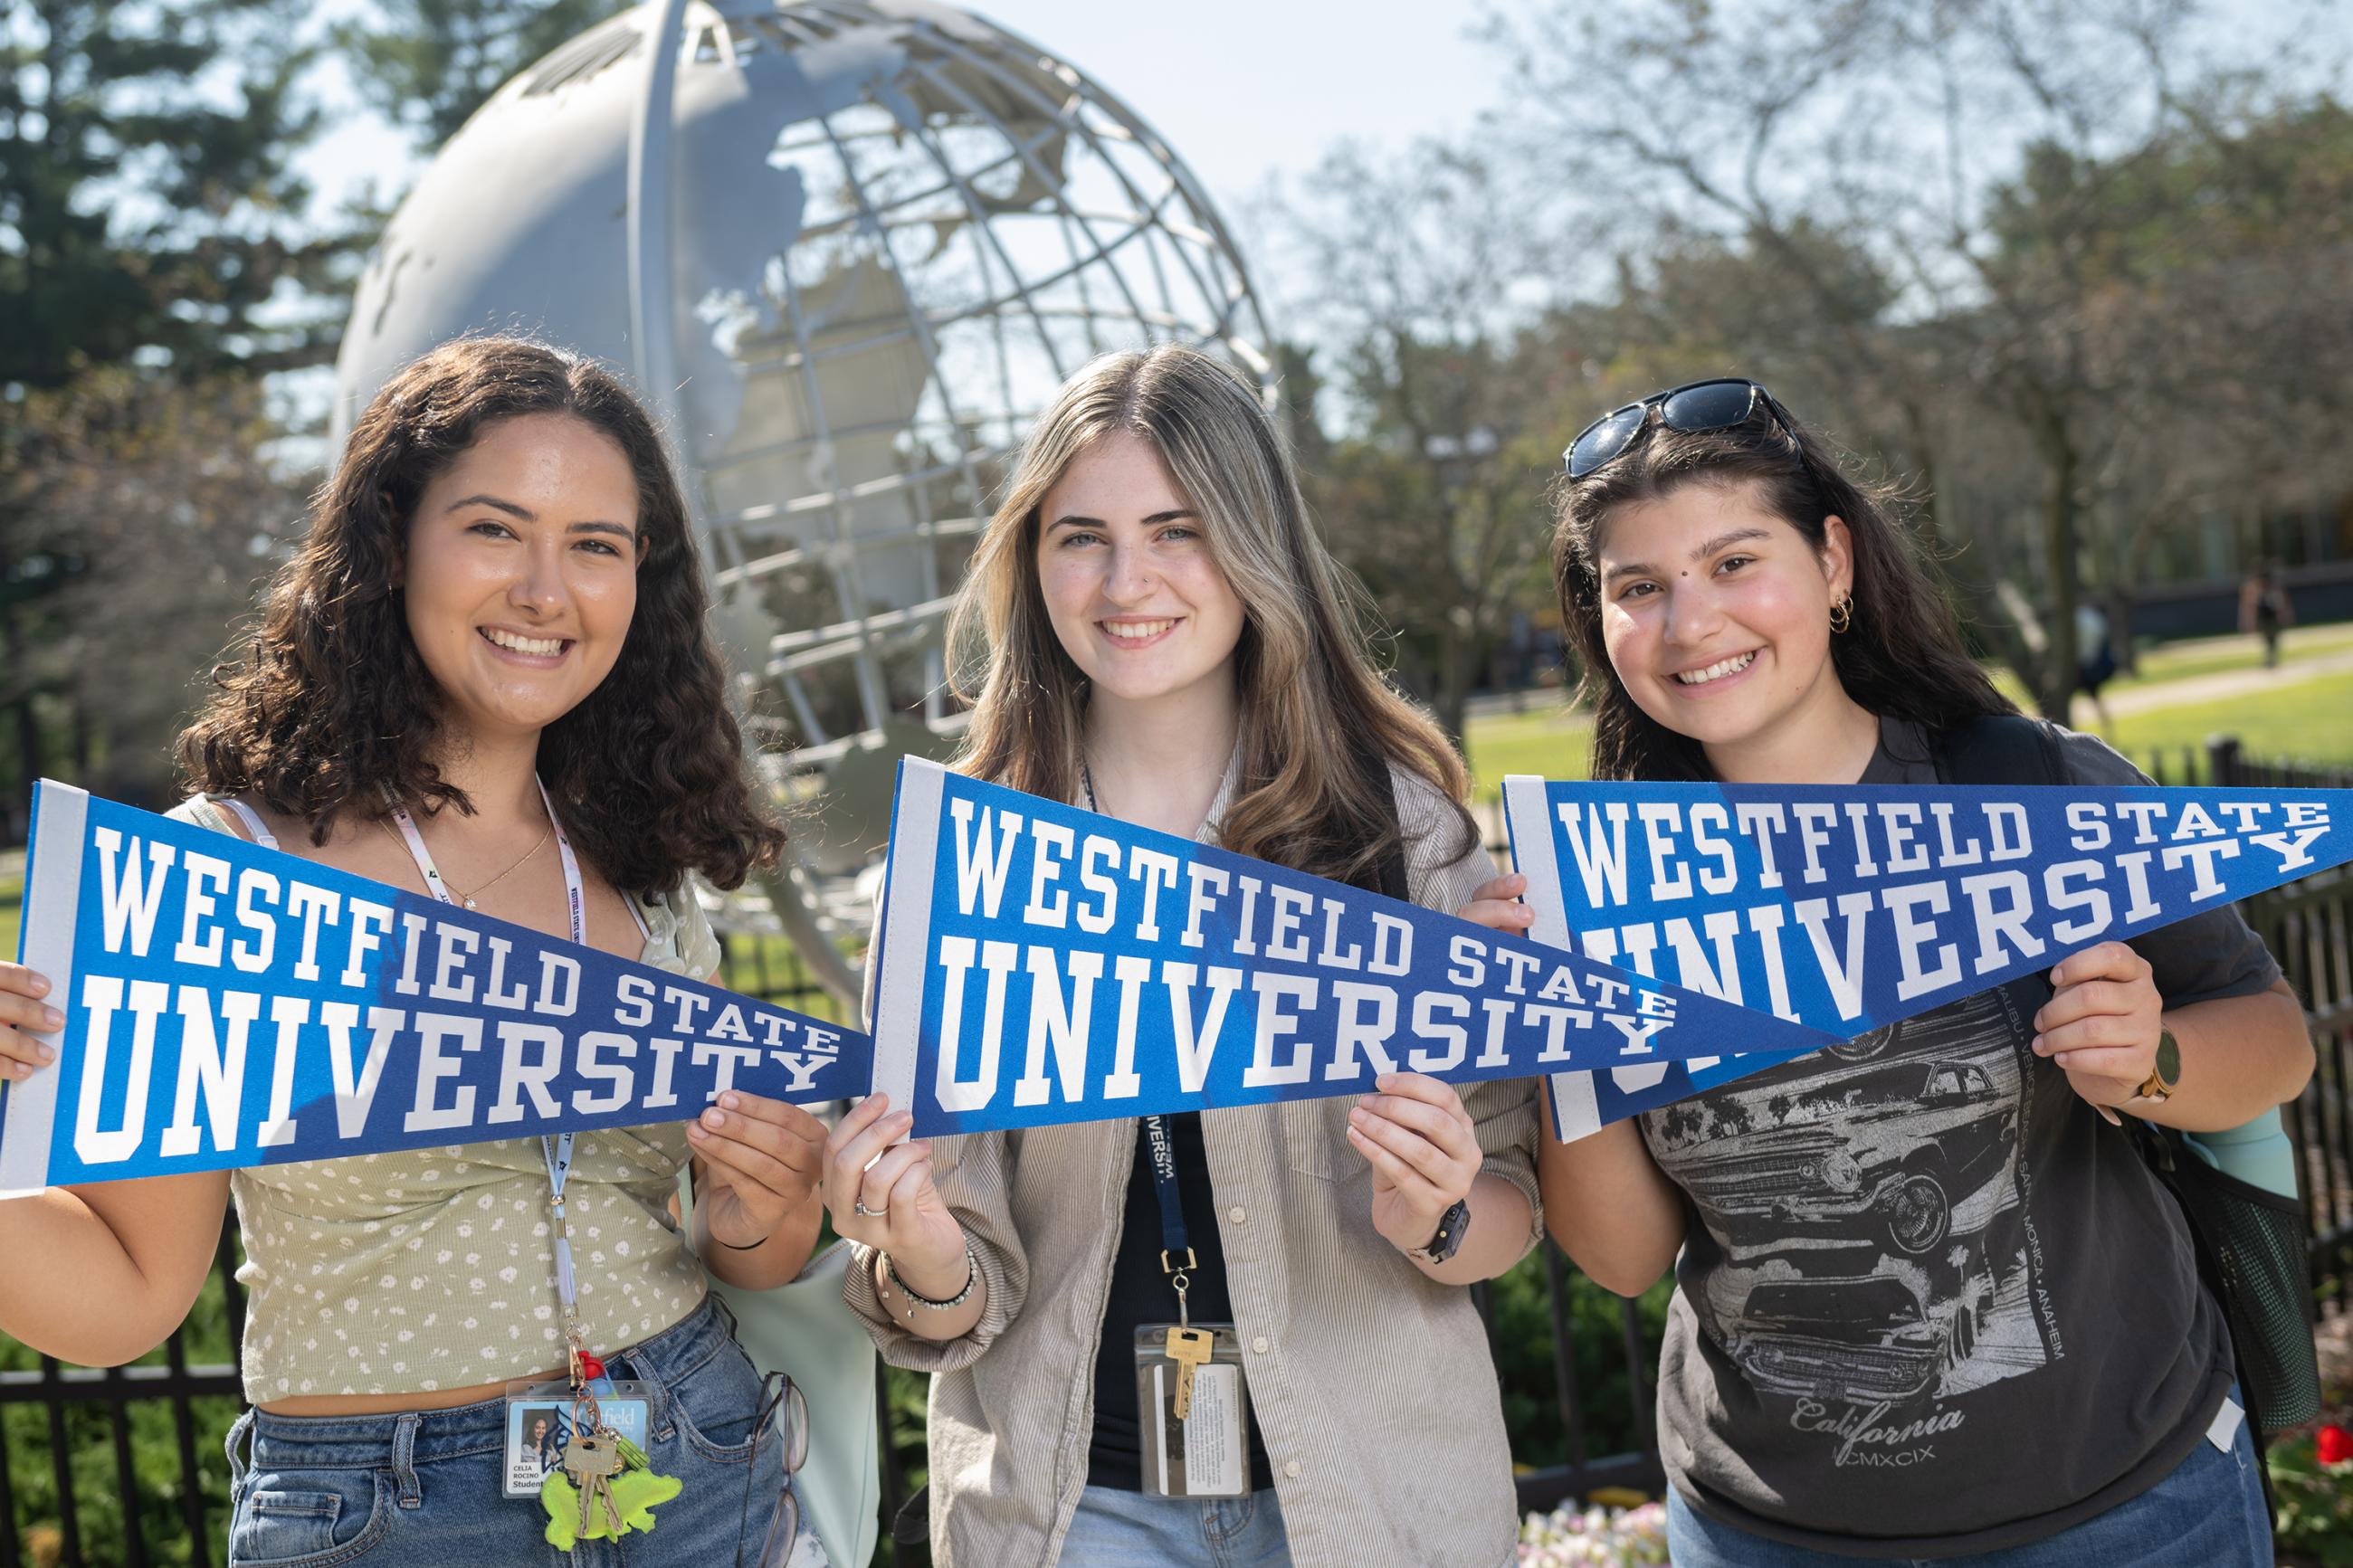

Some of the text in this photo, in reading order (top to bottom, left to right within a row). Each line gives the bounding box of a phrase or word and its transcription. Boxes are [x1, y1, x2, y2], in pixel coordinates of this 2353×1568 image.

[950, 796, 1678, 1019] WESTFIELD STATE
[1557, 802, 2331, 908] WESTFIELD STATE
[93, 826, 842, 1054] WESTFIELD STATE
[74, 974, 838, 1165] UNIVERSITY
[934, 935, 1674, 1113] UNIVERSITY
[2021, 1044, 2035, 1098] VENICE
[2023, 1215, 2044, 1278] MONICA
[2036, 1288, 2065, 1360] ANAHEIM
[1790, 1397, 1966, 1468] California
